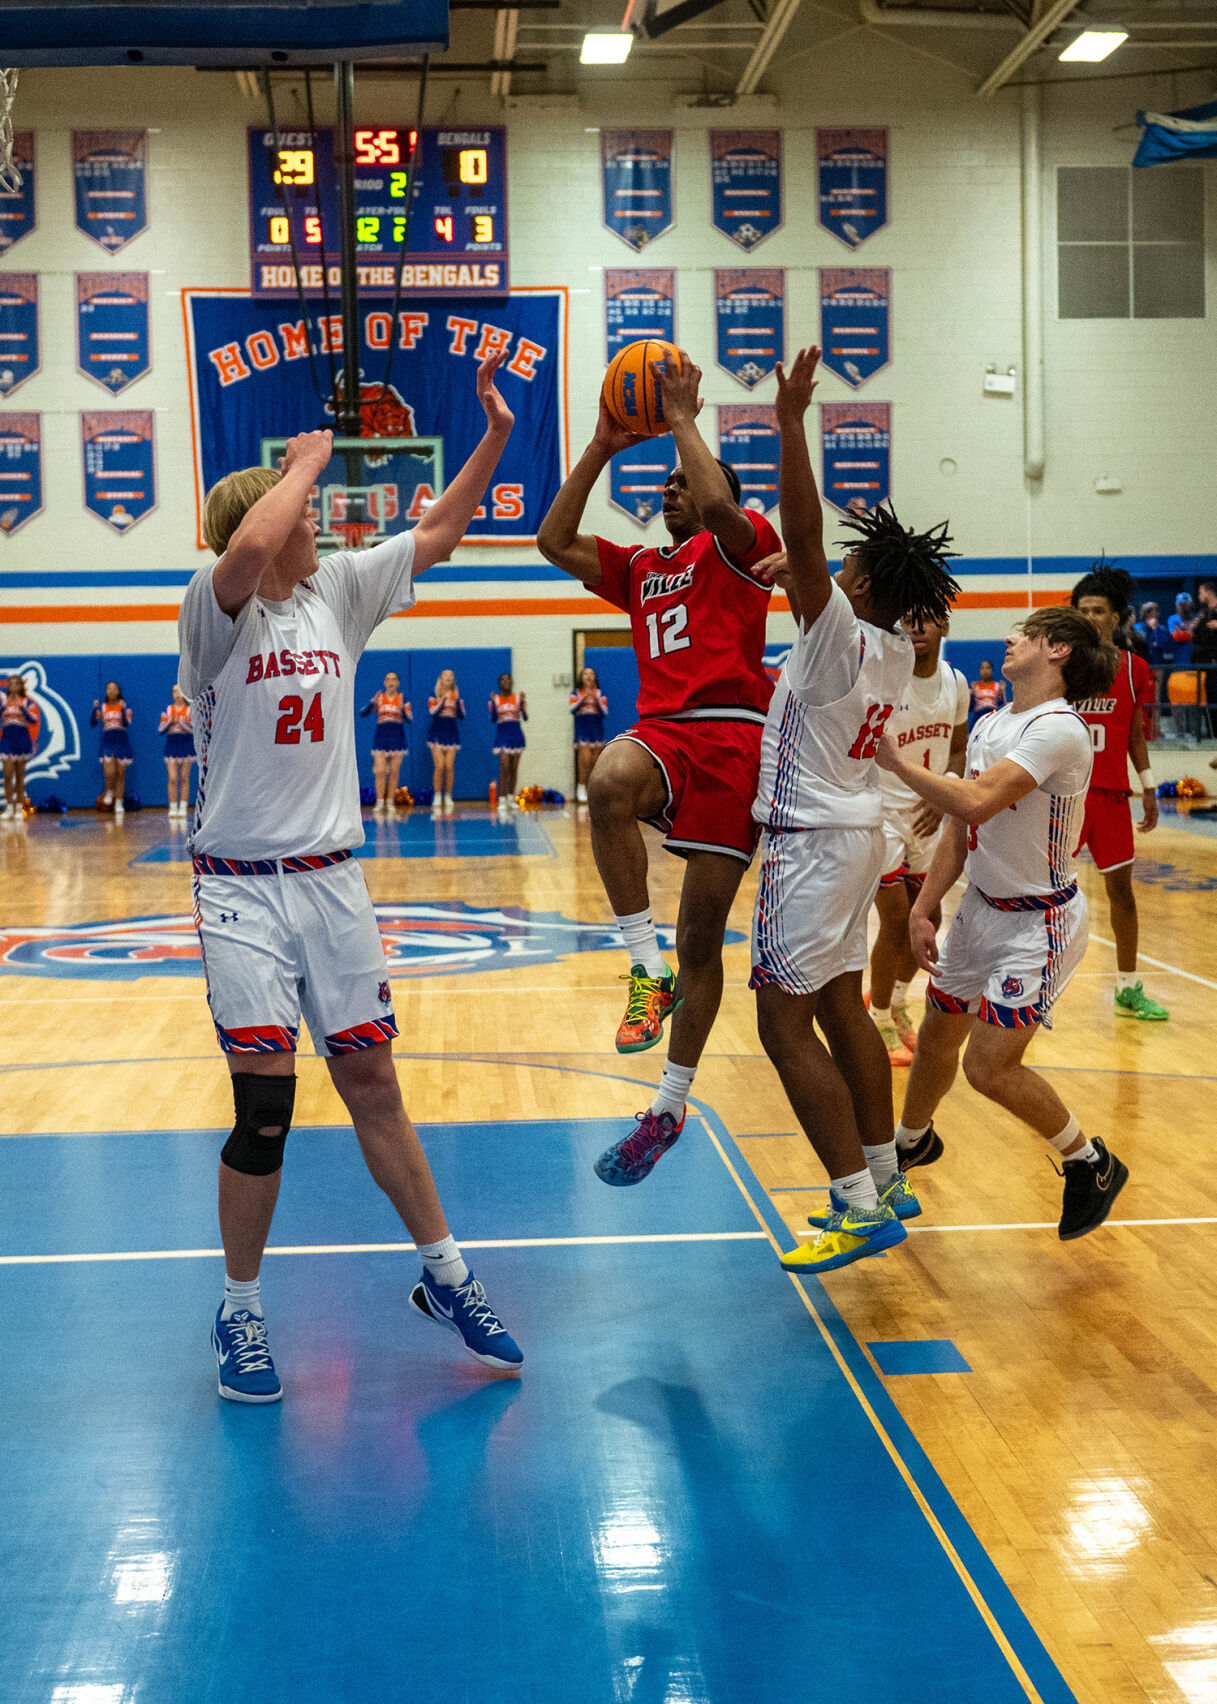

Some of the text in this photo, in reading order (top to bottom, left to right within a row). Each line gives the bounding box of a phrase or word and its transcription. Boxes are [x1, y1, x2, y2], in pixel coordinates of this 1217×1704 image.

[390, 172, 407, 197] 2
[304, 216, 323, 244] 5
[435, 215, 453, 243] 4
[474, 215, 493, 242] 3
[261, 264, 500, 289] HOME O THE BENGALS
[208, 314, 343, 387] HOME
[365, 312, 429, 350] OF
[446, 315, 547, 382] THE
[645, 603, 692, 660] 12
[245, 649, 341, 685] BASSETT
[274, 691, 325, 745] 24
[1072, 697, 1118, 714] VILLE
